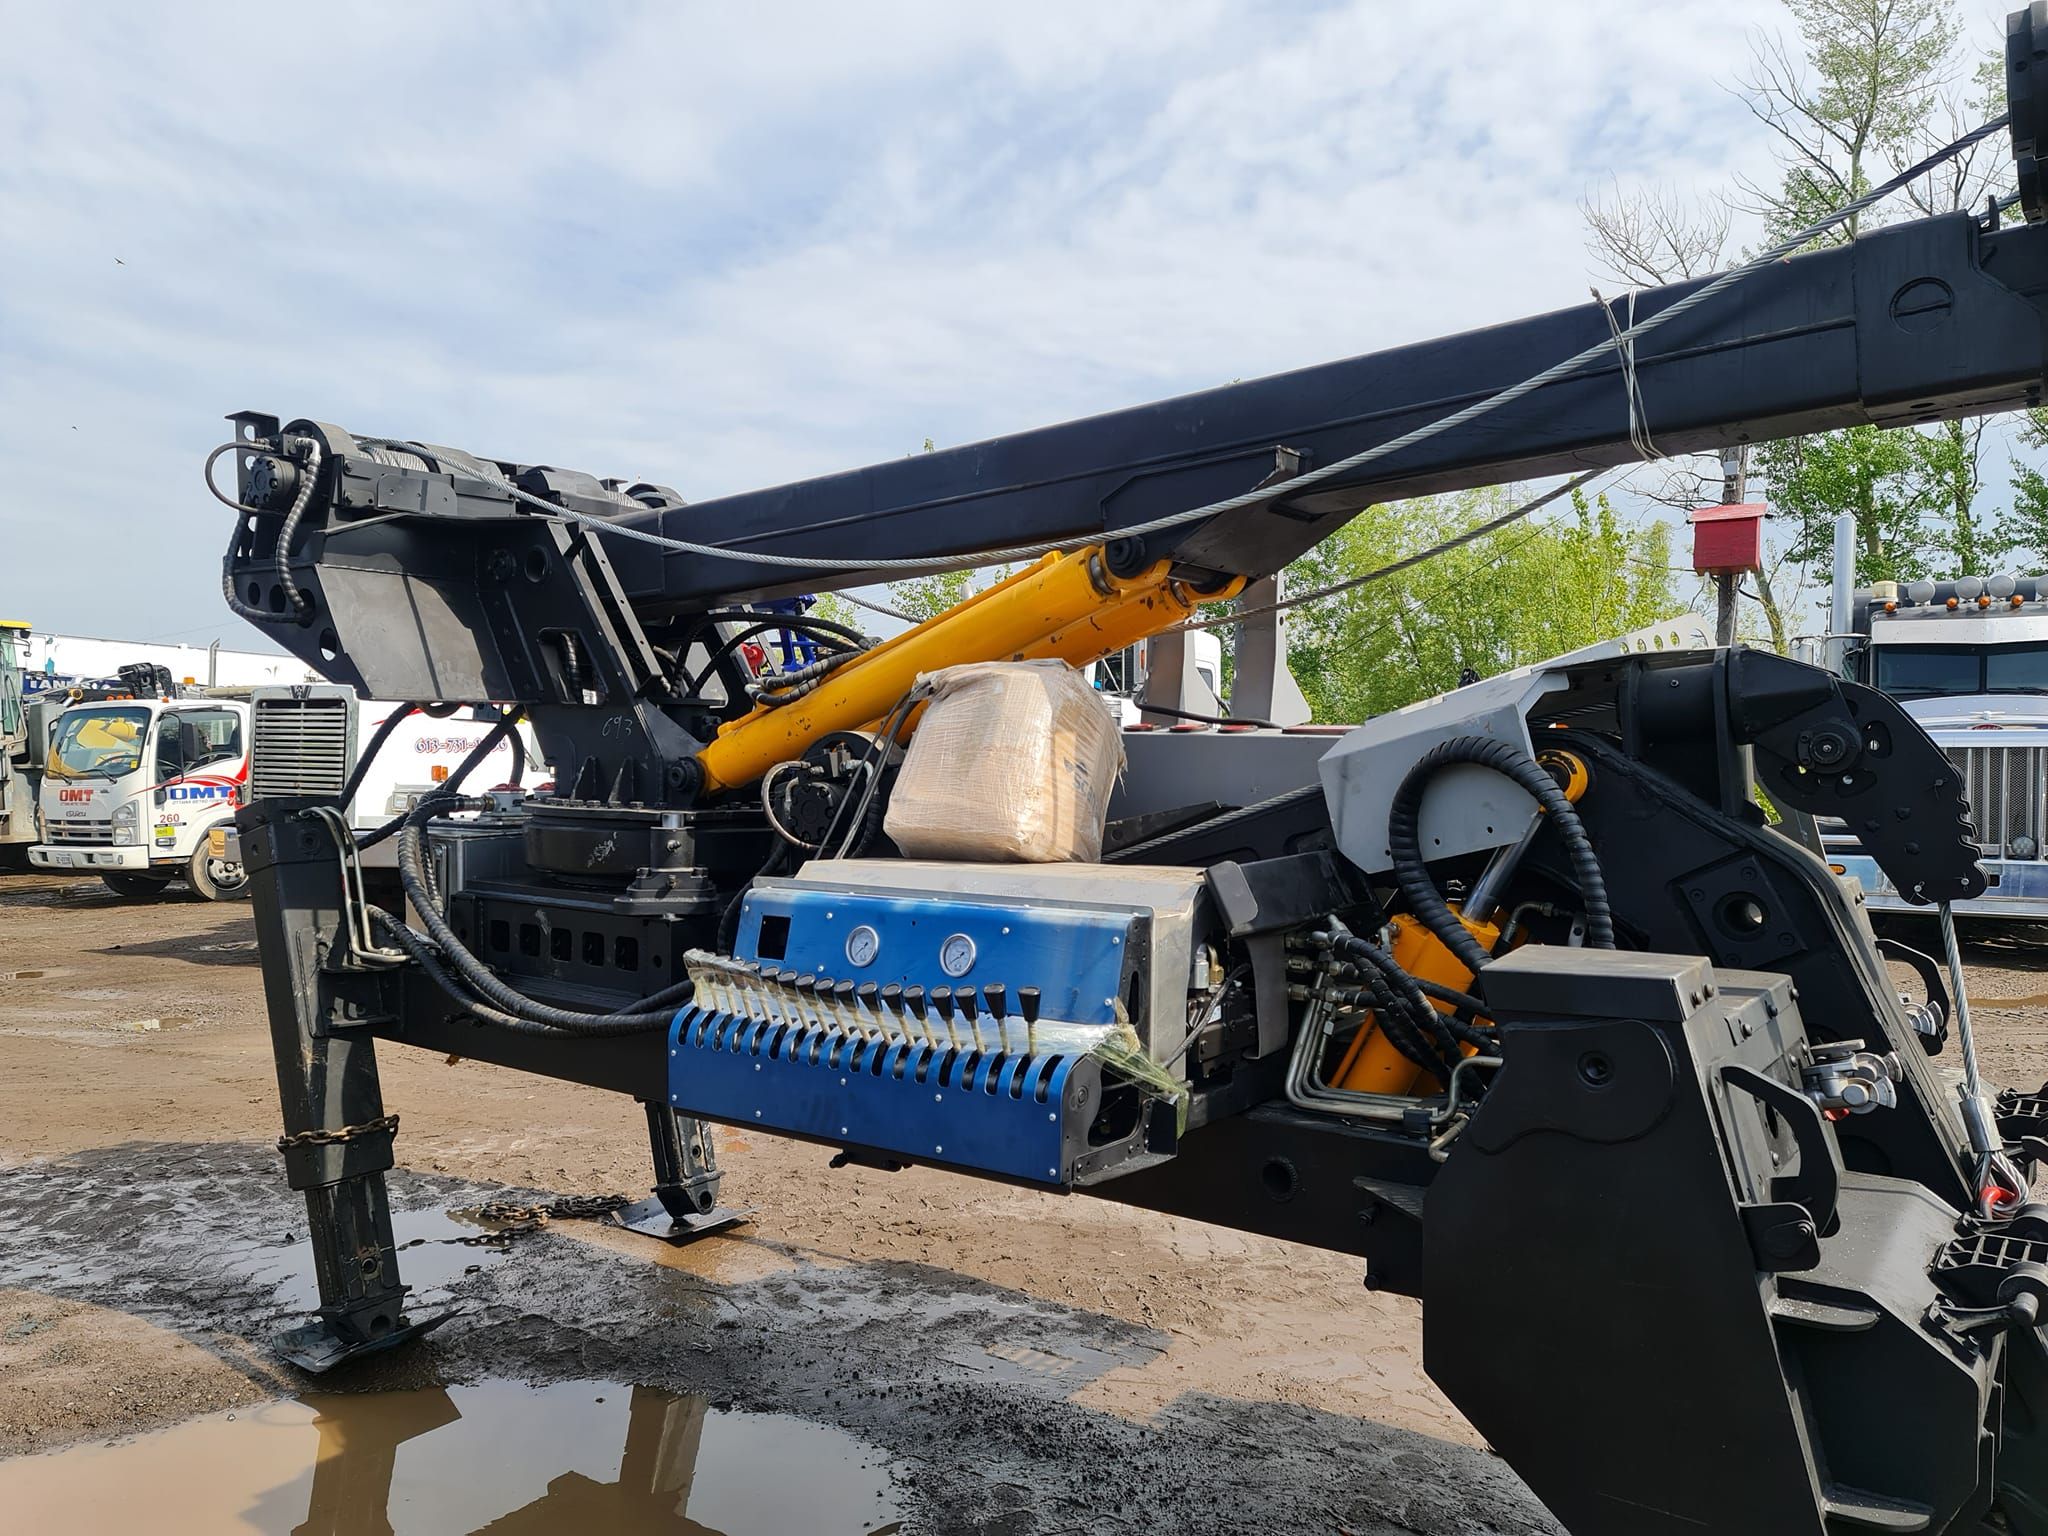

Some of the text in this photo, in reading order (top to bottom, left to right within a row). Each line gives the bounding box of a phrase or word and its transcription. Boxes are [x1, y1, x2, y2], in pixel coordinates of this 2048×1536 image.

[602, 715, 633, 739] 693
[60, 789, 94, 802] OMT
[170, 786, 232, 800] OMT
[160, 813, 180, 824] 260
